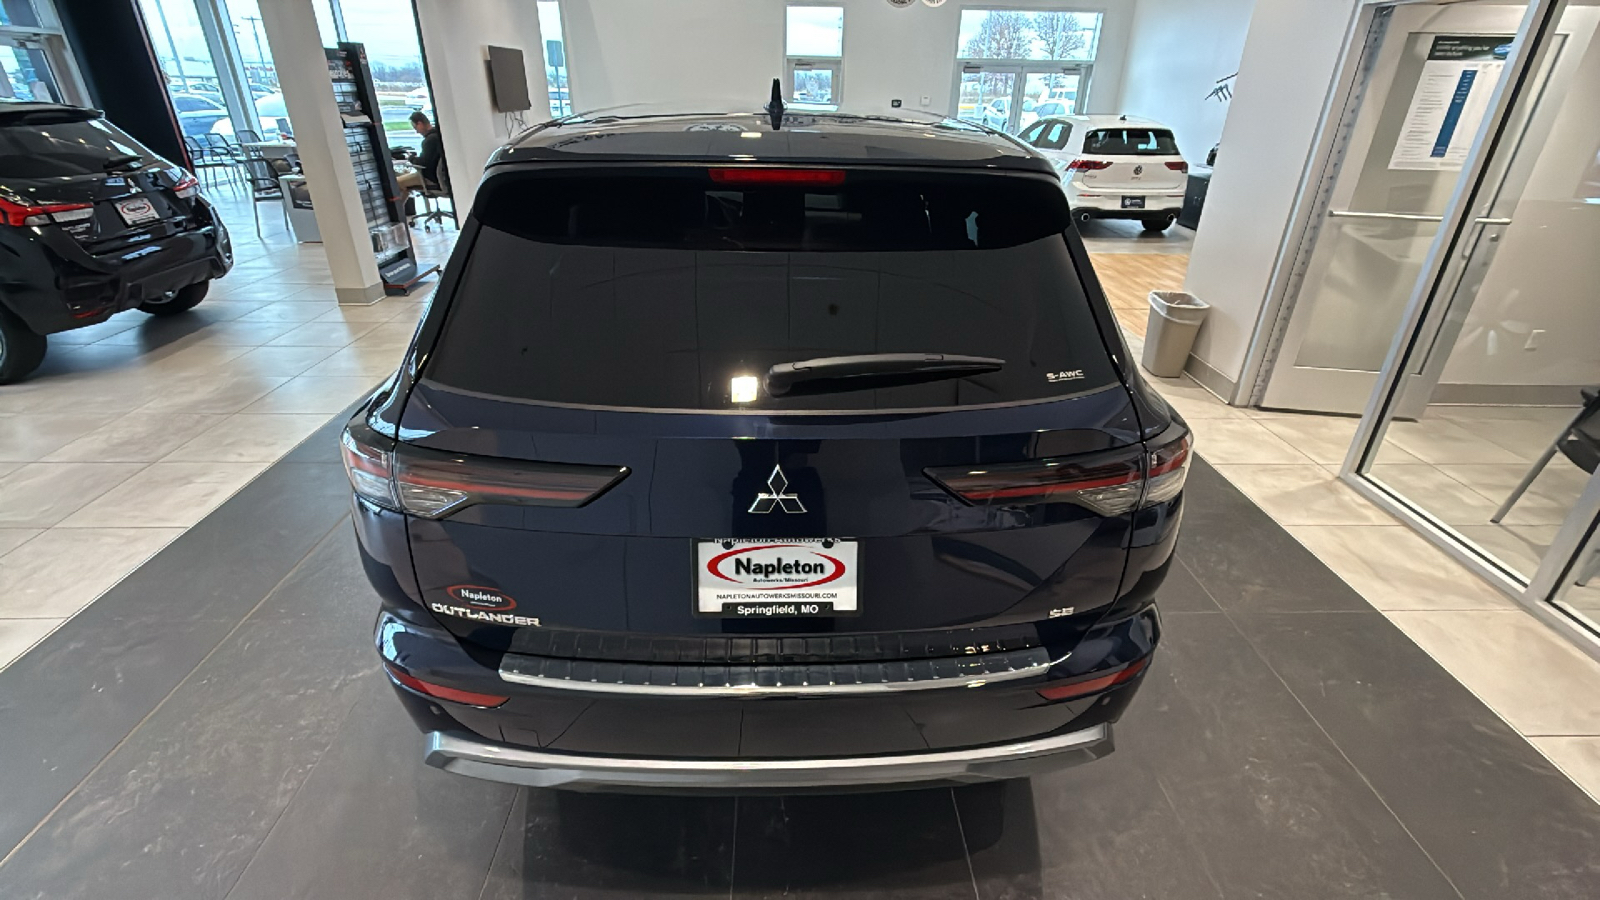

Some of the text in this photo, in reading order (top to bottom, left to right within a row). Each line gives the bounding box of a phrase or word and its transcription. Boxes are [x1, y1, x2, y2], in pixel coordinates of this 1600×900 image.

[1046, 369, 1084, 380] S-AWC
[734, 557, 825, 578] Napleton
[461, 588, 503, 603] Napleton
[716, 592, 838, 600] NAPLETONAUTOWERKSMISSOURI.COM
[431, 602, 542, 627] OUTLANDER
[737, 604, 819, 616] Springfield, MO
